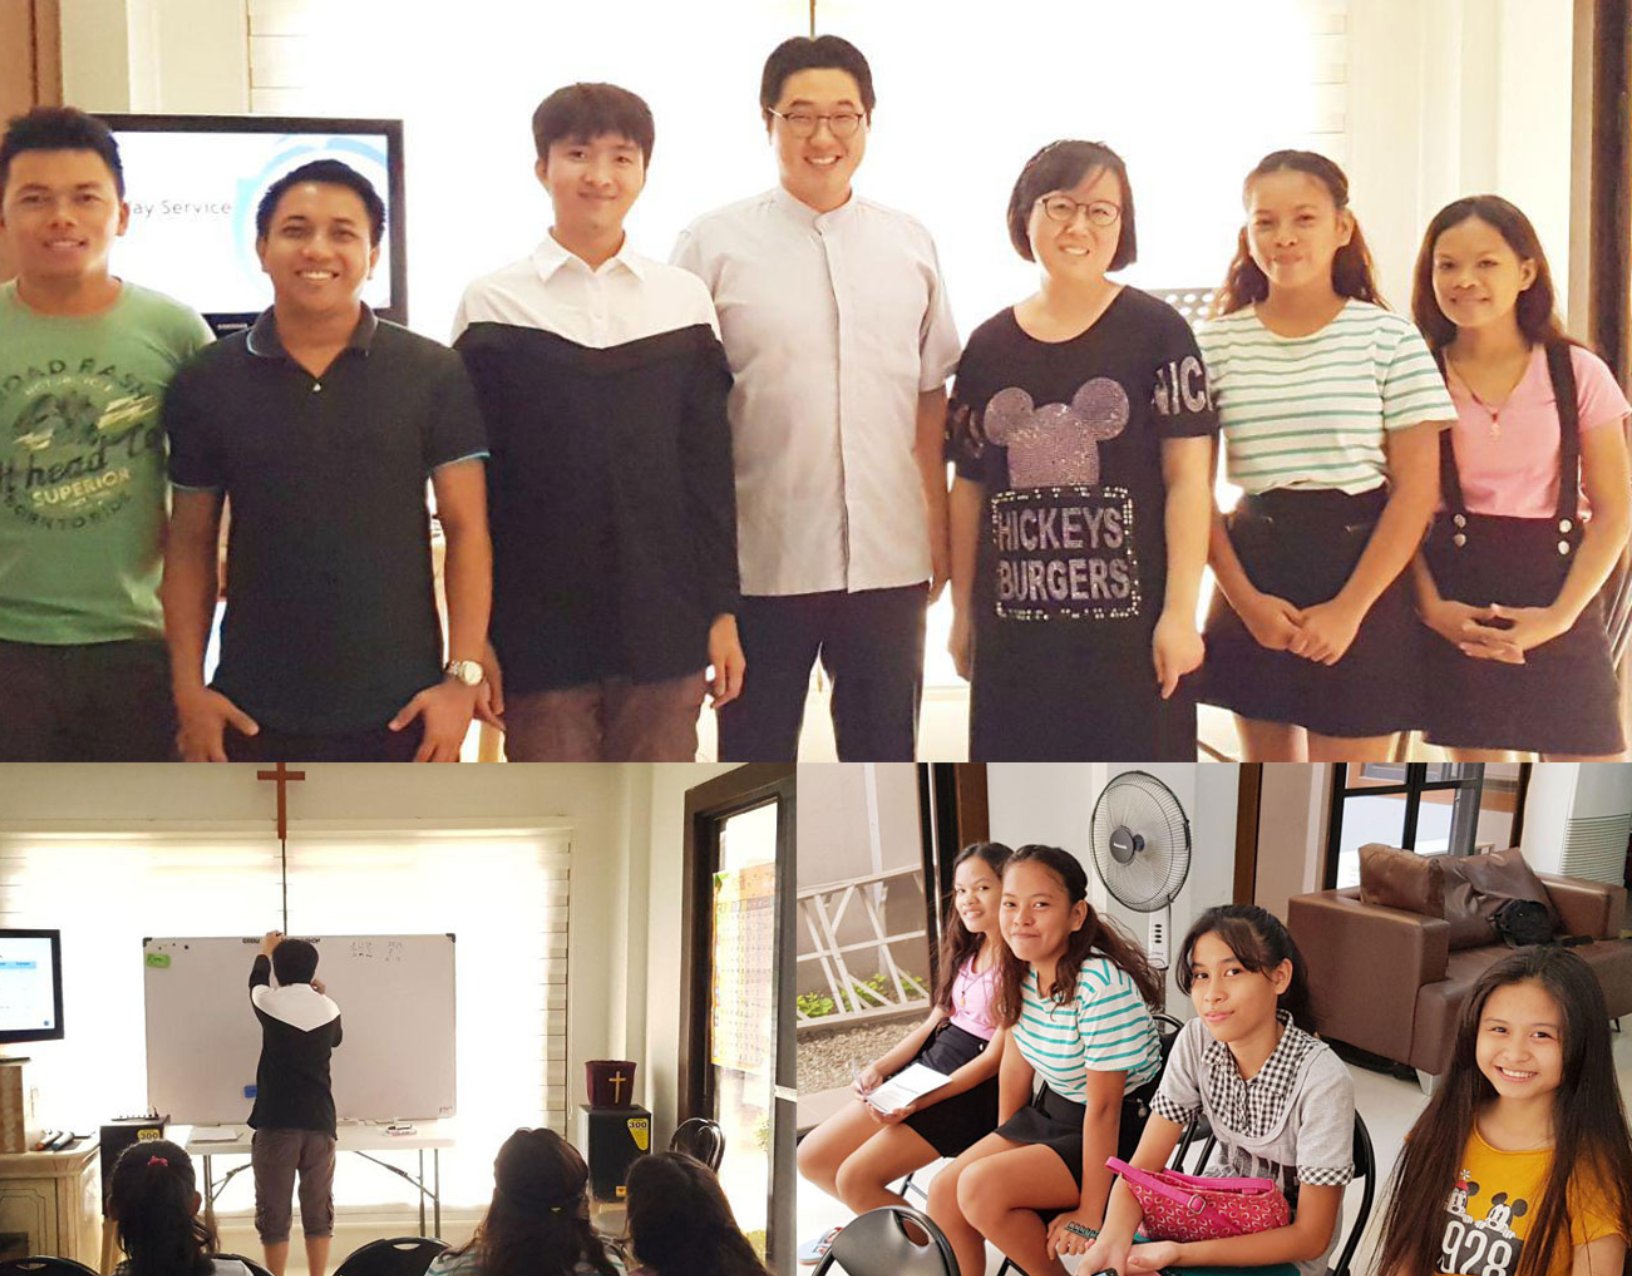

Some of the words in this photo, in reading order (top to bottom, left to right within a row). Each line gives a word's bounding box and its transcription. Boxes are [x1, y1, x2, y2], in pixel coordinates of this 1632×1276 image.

[129, 199, 154, 218] ay
[161, 199, 232, 214] Service
[998, 507, 1124, 551] HICKEYS
[997, 558, 1130, 601] BURGERS
